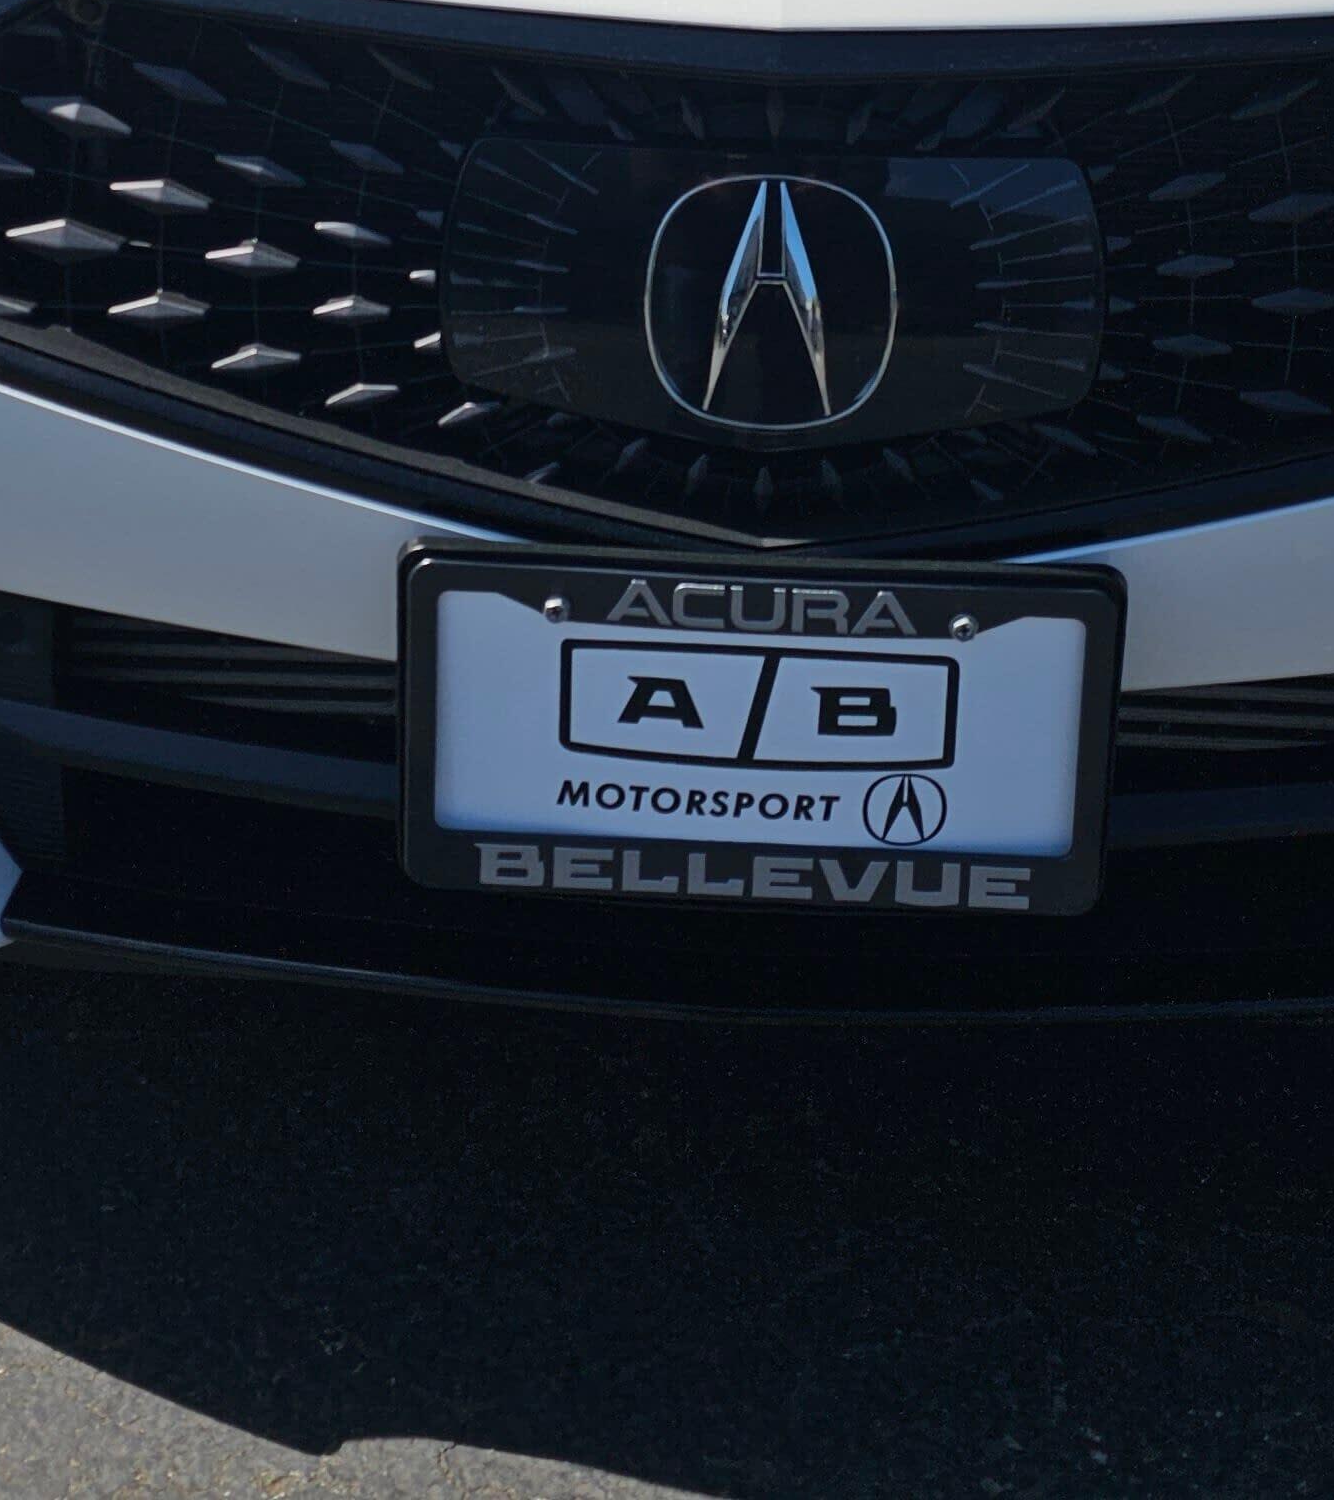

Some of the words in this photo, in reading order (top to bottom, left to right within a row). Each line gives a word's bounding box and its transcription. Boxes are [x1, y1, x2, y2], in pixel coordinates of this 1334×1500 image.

[605, 578, 918, 637] ACURA
[616, 674, 705, 730] A
[809, 685, 898, 737] B
[556, 779, 841, 822] MOTORSPORT
[473, 841, 1033, 911] BELLEVUE
